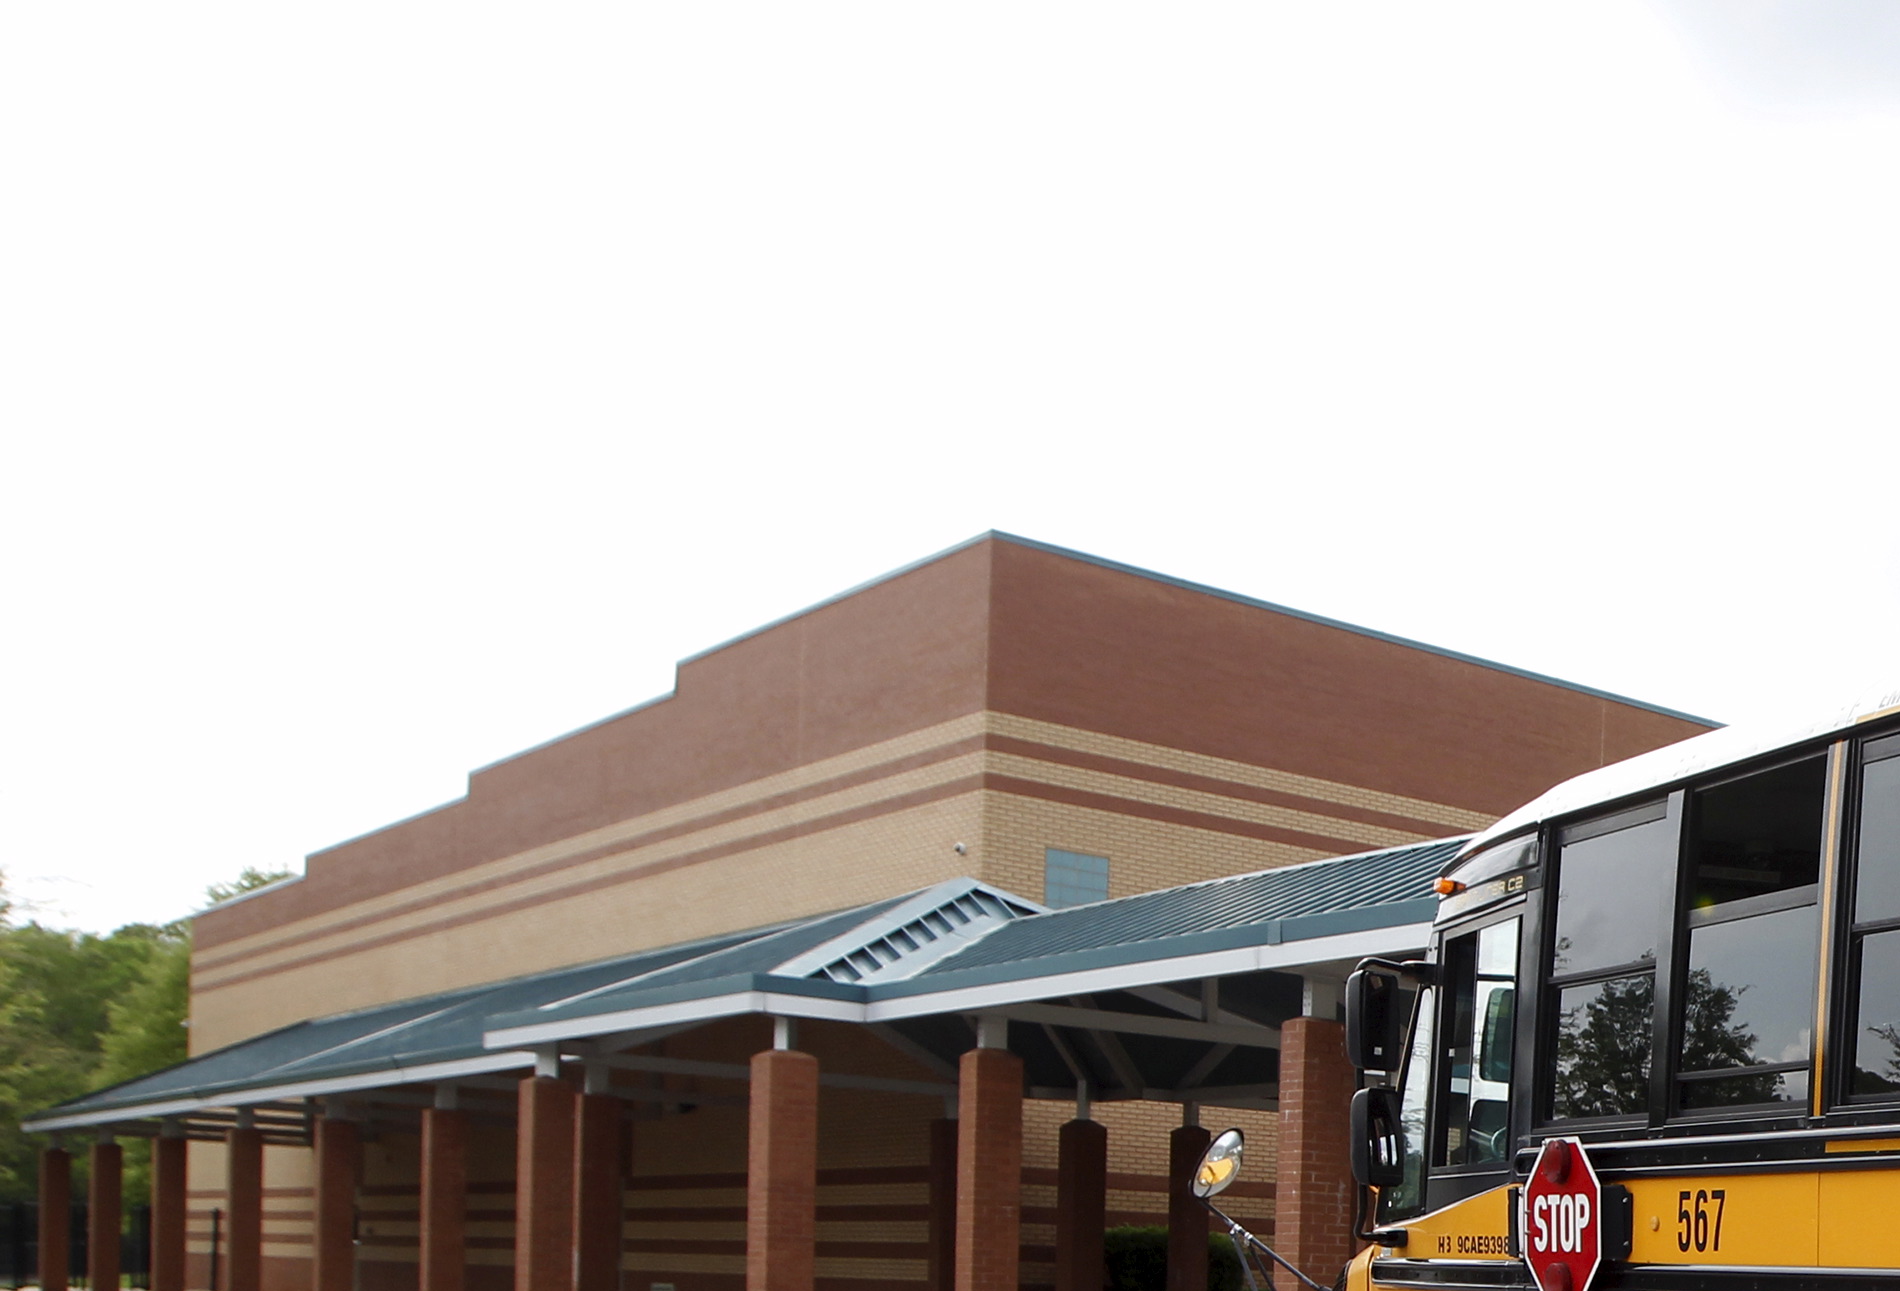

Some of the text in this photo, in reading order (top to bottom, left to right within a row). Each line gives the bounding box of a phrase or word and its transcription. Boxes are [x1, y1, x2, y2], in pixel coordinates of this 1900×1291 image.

[1508, 876, 1523, 891] C2
[1533, 1193, 1591, 1253] STOP
[1677, 1189, 1726, 1253] 567
